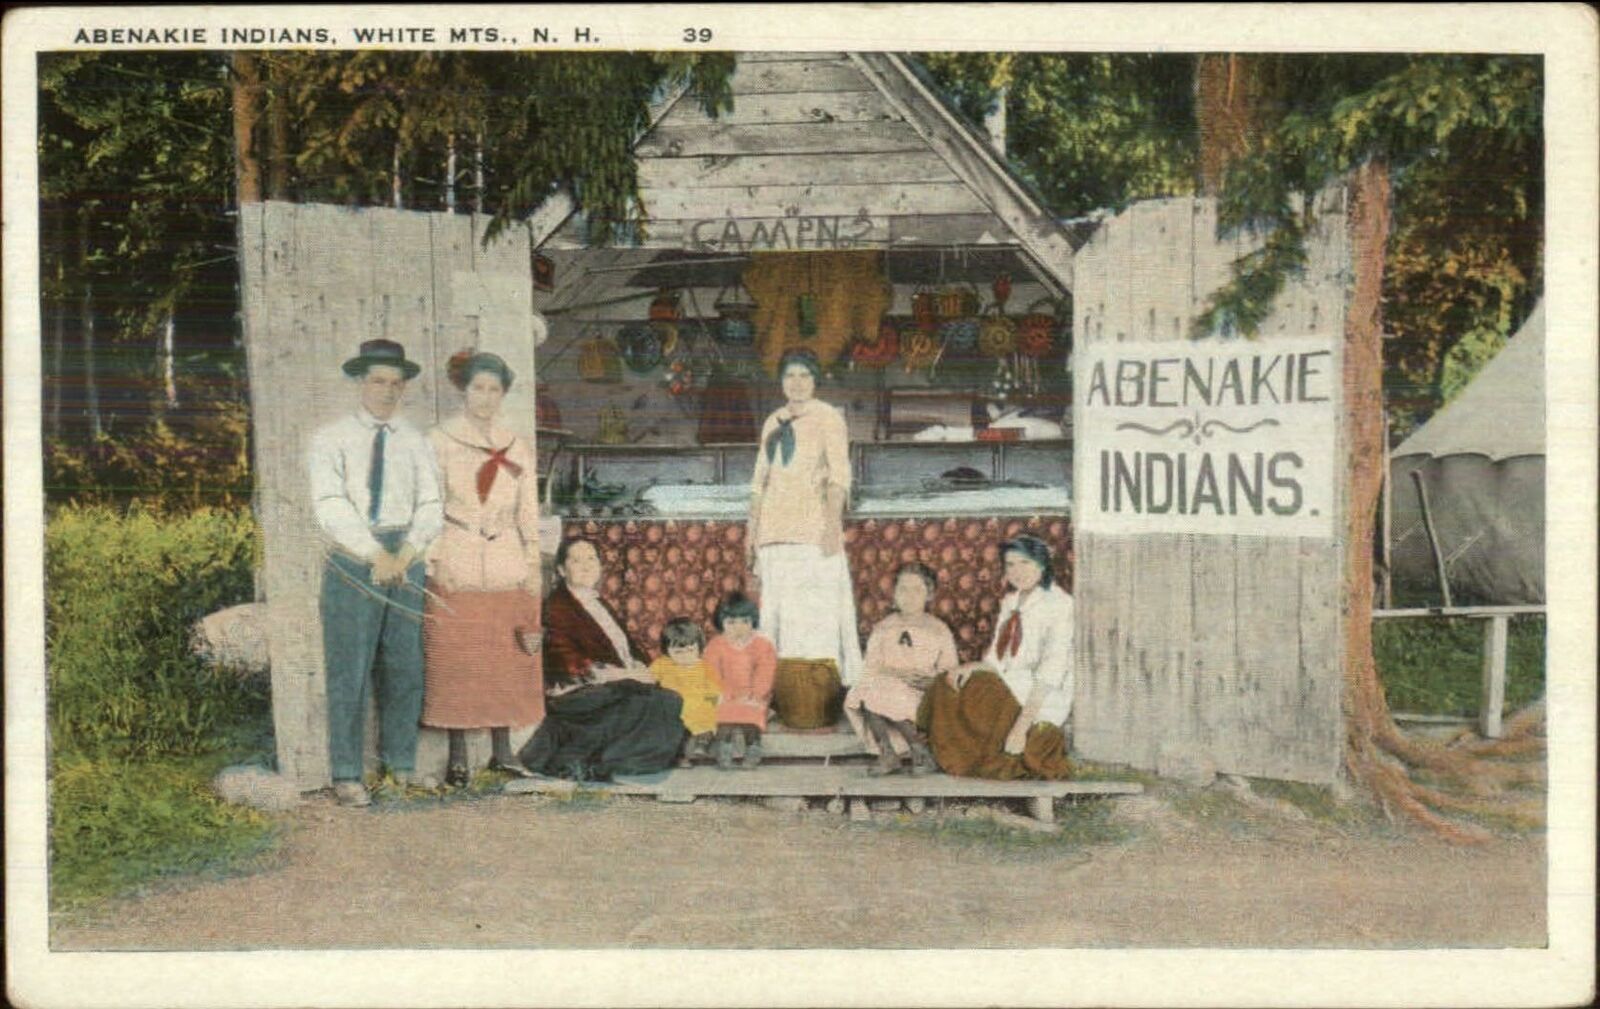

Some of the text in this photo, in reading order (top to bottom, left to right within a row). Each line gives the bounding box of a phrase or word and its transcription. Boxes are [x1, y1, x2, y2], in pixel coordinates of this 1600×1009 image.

[1086, 350, 1332, 407] ABENAKIE
[1100, 450, 1320, 516] INDIANS.
[898, 630, 913, 648] A
